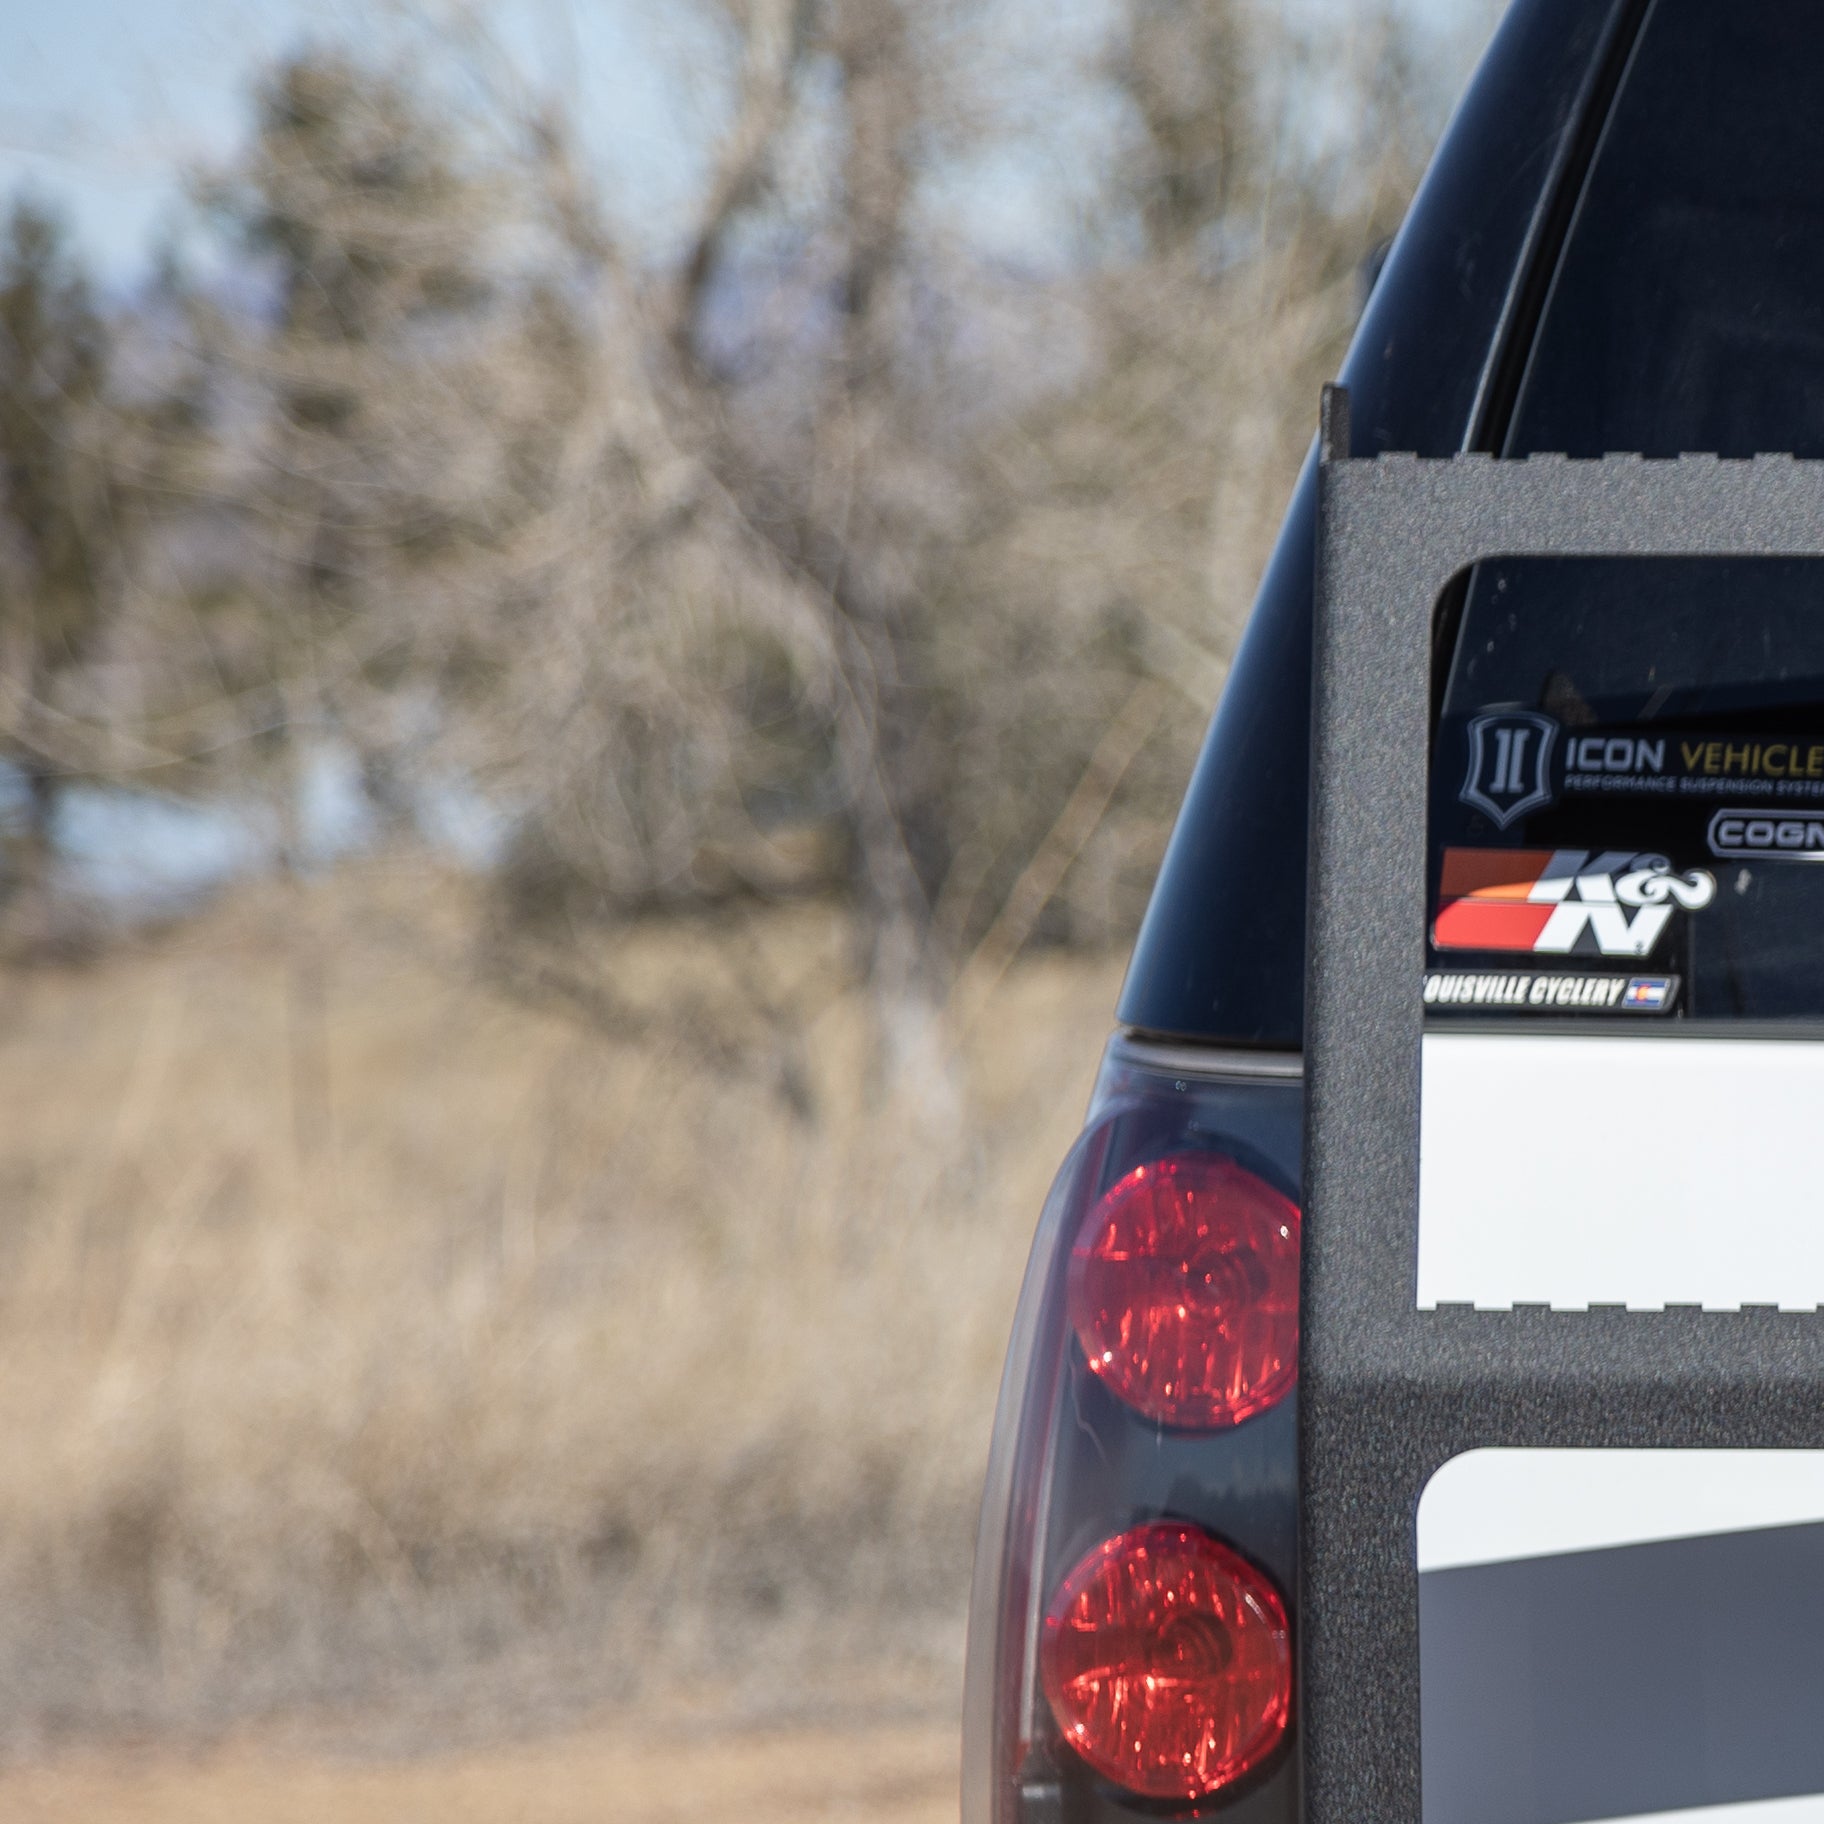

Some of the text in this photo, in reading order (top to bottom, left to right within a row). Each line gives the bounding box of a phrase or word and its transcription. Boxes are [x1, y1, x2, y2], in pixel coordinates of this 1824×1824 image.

[1565, 737, 1666, 773] ICON
[1423, 974, 1627, 1007] OUISVILLE CYCLERY
